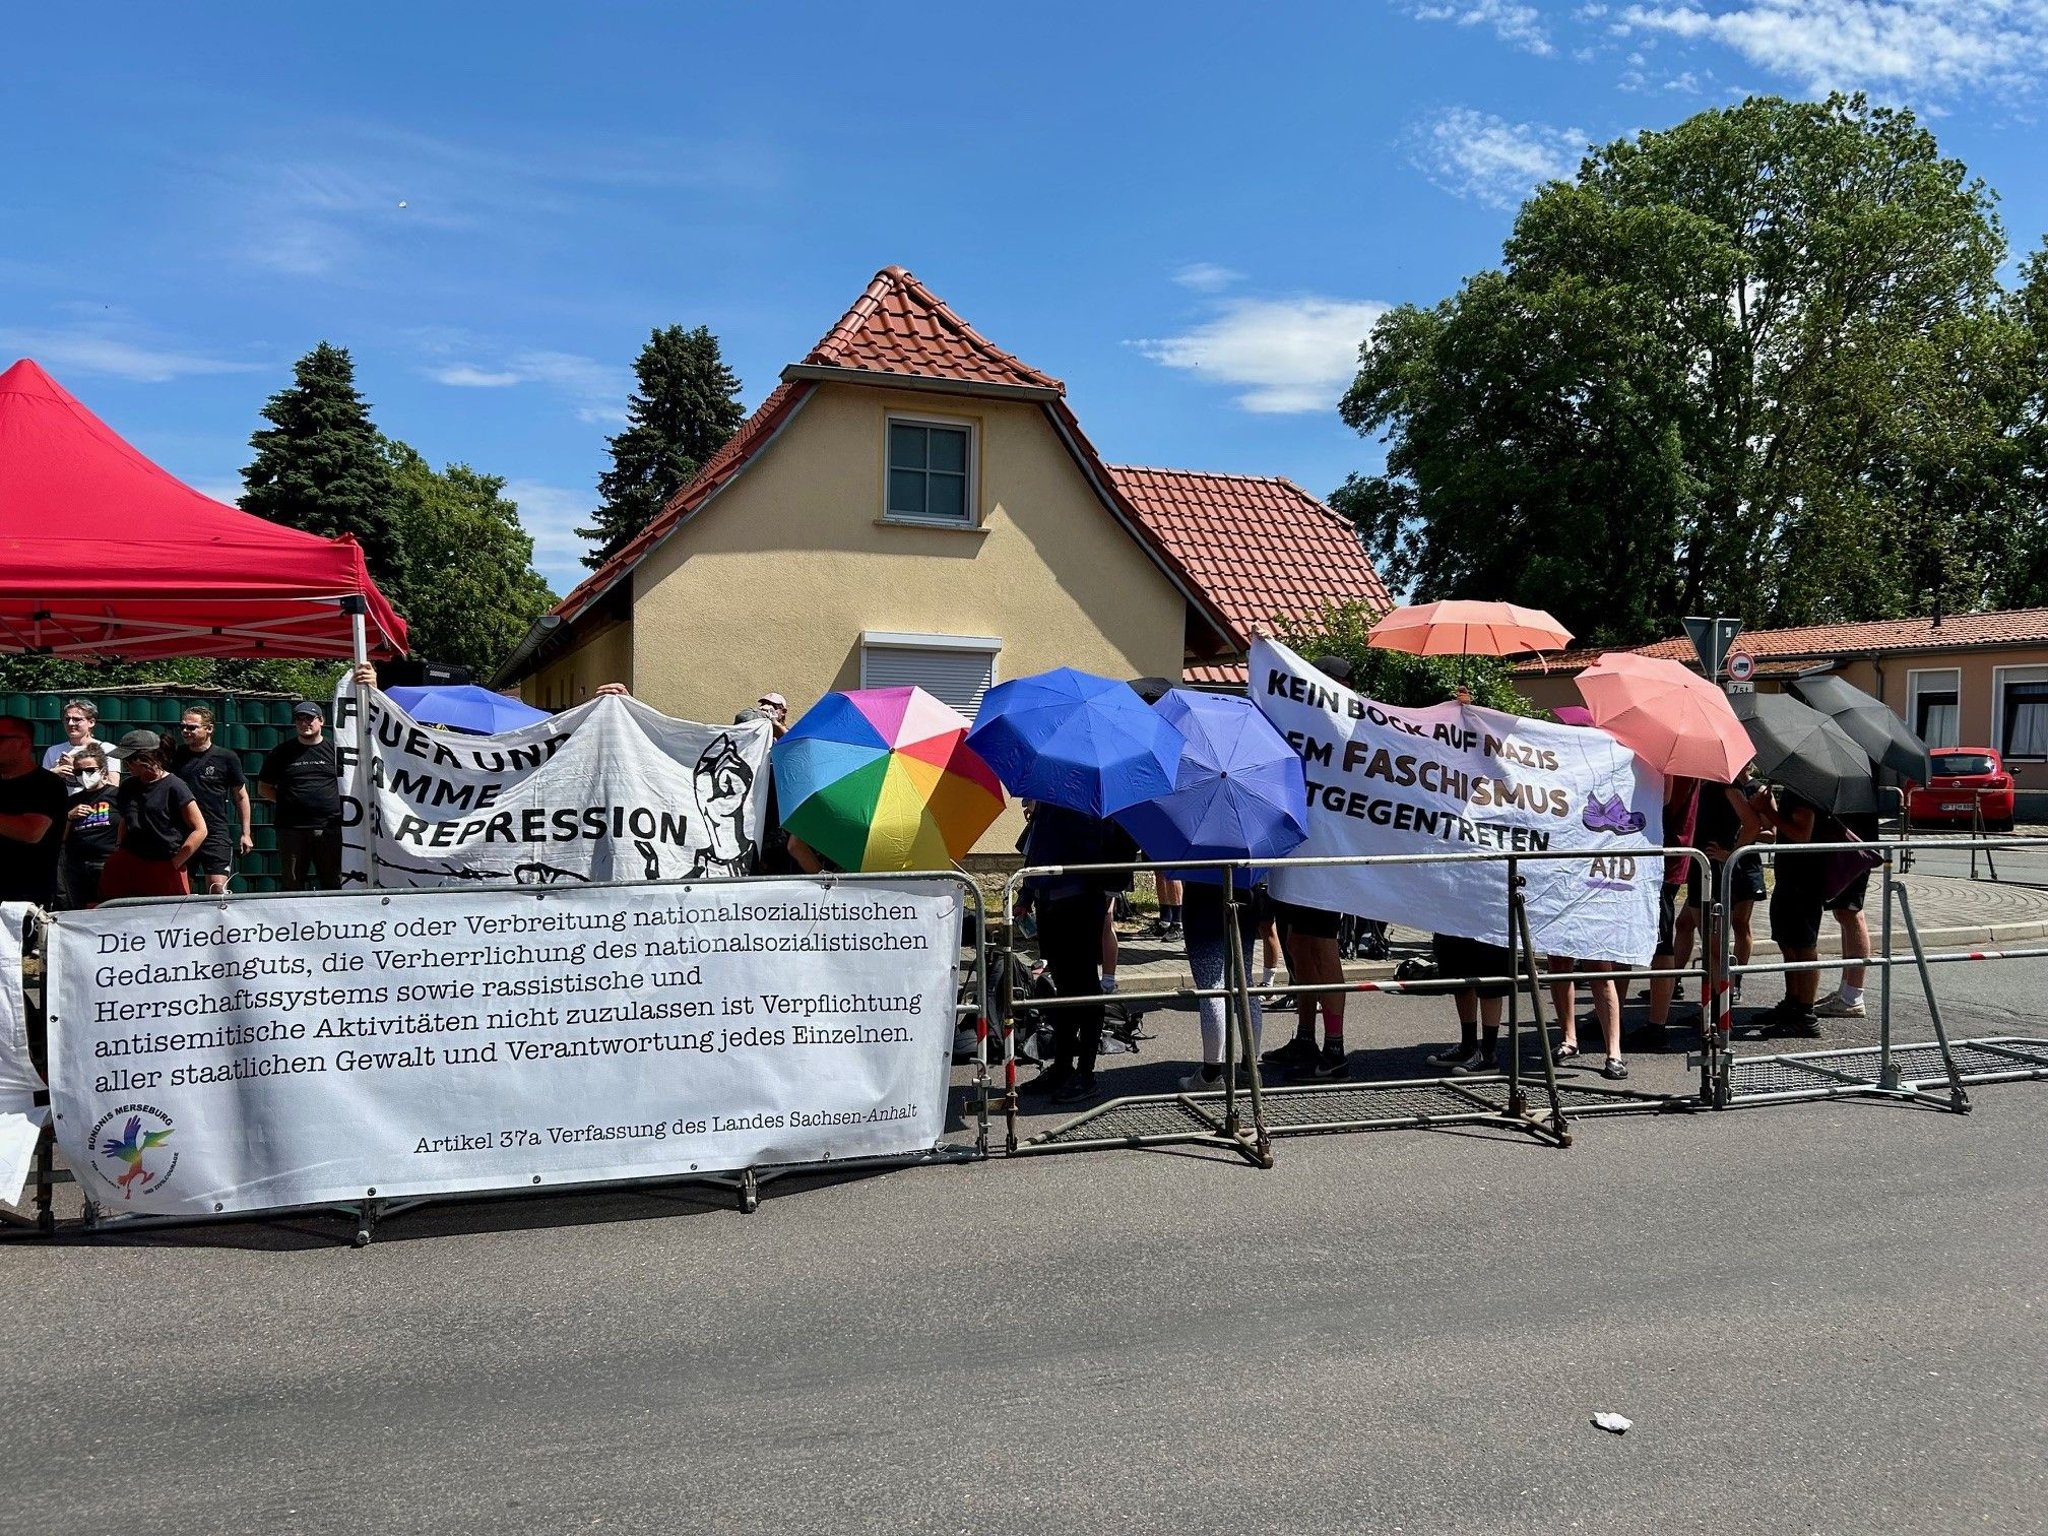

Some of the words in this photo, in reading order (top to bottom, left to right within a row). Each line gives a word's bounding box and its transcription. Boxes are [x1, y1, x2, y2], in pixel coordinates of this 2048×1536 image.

[1267, 668, 1339, 714] KEIN
[1347, 697, 1431, 738] BOCK
[1432, 723, 1477, 753] AUF
[1484, 734, 1559, 772] NAZIS
[335, 746, 502, 811] FAMME
[1287, 730, 1333, 768] EM
[1342, 740, 1570, 818] FASCHISMUS
[339, 795, 383, 839] DR
[394, 806, 687, 848] REPRESSION
[1305, 780, 1550, 851] TGEGENTRETEN
[1589, 856, 1636, 882] AfD
[97, 933, 146, 955] Die
[154, 920, 387, 950] Wiederbelebung
[393, 917, 457, 938] oder
[464, 910, 627, 935] Verbreitung
[633, 902, 918, 927] nationalsozialistischen
[95, 954, 313, 988] Gedankenguts,
[322, 952, 364, 973] die
[372, 943, 586, 970] Verherrlichung
[593, 940, 637, 960] des
[644, 932, 929, 957] nationalsozialistischen
[94, 986, 389, 1023] Herrschaftssystems
[396, 980, 474, 1002] sowie
[482, 971, 644, 998] rassistische
[651, 966, 703, 988] und
[94, 1020, 306, 1058] antisemitische
[313, 1013, 480, 1039] Aktivitäten
[486, 1008, 559, 1030] nicht
[566, 1000, 716, 1025] zuzulassen
[721, 996, 754, 1016] ist
[760, 993, 922, 1017] Verpflichtung
[95, 1069, 162, 1093] aller
[170, 1054, 327, 1087] staatlichen
[335, 1046, 436, 1072] Gewalt
[443, 1042, 498, 1065] und
[505, 1031, 714, 1061] Verantwortung
[718, 1026, 785, 1053] jedes
[791, 1024, 914, 1045] Einzelnen.
[88, 1112, 114, 1150] BÜNDNIS
[114, 1103, 173, 1126] MERSEBURG
[413, 1132, 494, 1154] Artikel
[499, 1130, 542, 1148] 37a
[546, 1121, 667, 1145] Verfassung
[672, 1118, 707, 1135] des
[712, 1113, 784, 1132] Landes
[789, 1103, 918, 1128] Sachsen-Anhalt
